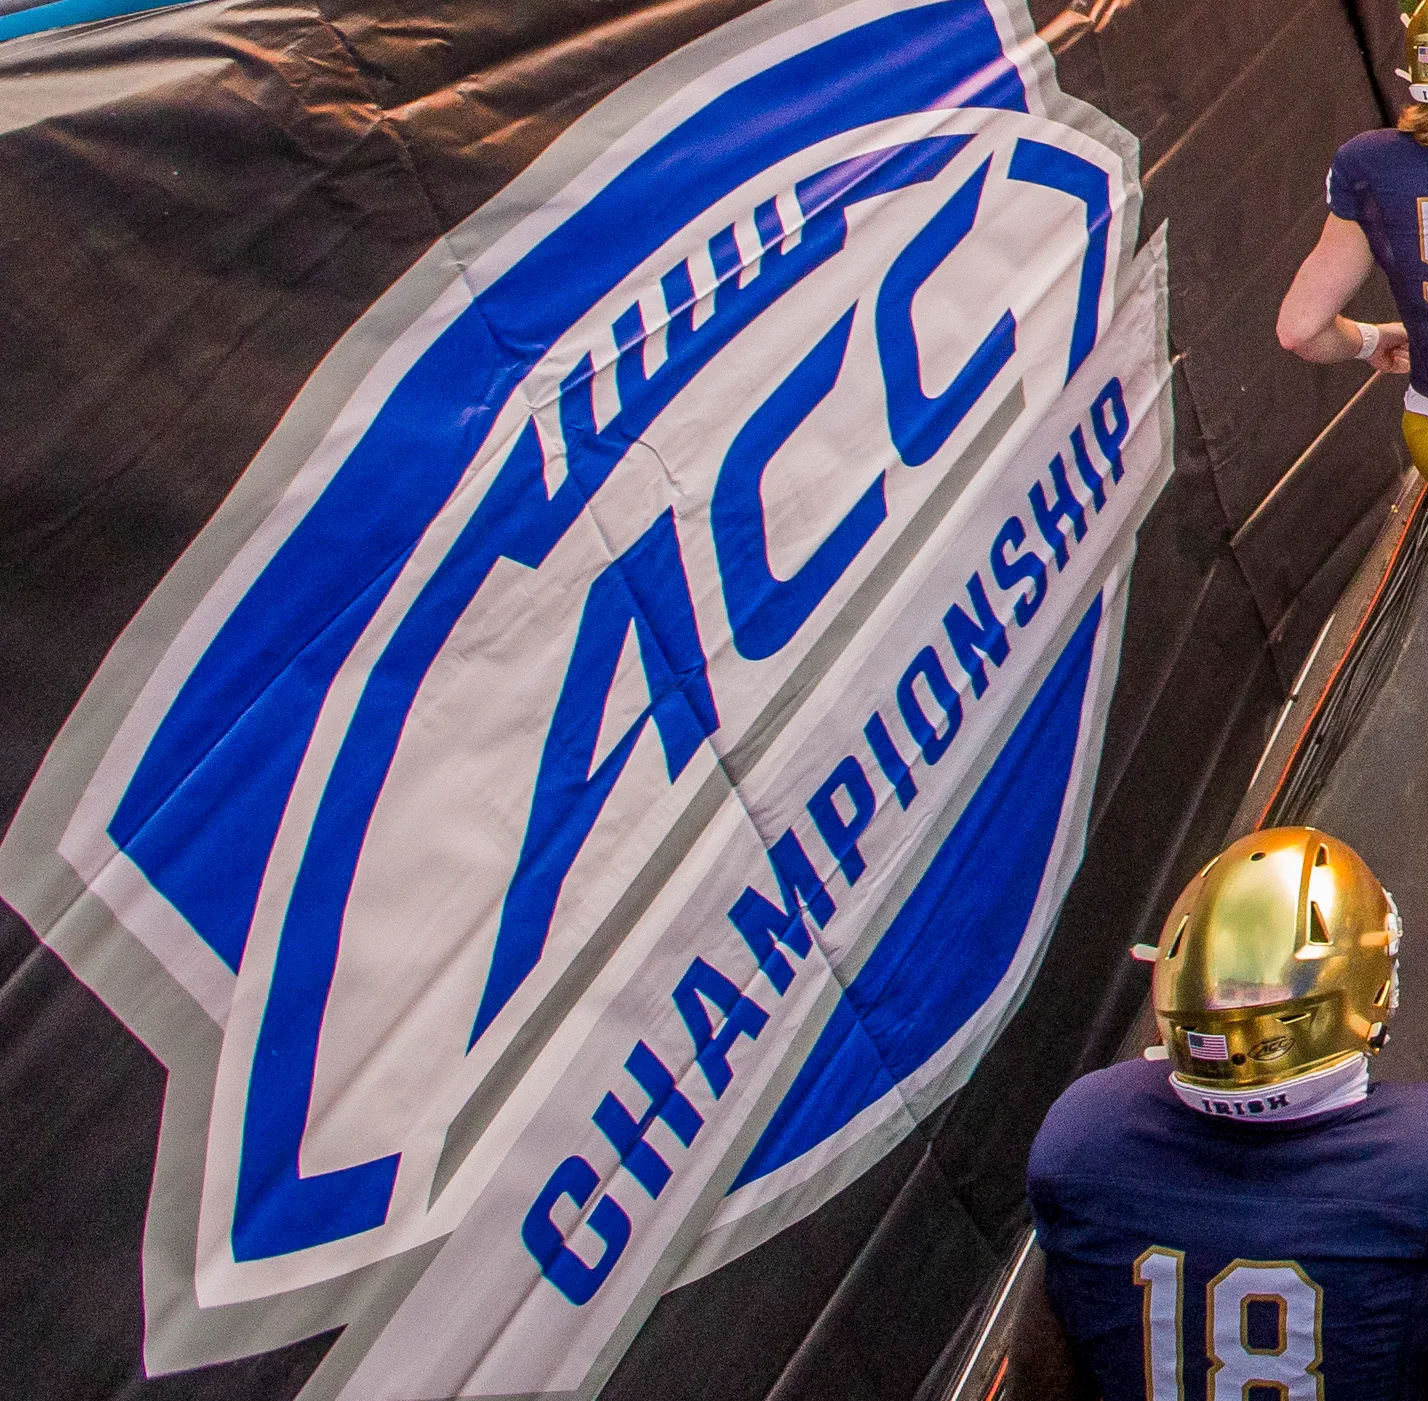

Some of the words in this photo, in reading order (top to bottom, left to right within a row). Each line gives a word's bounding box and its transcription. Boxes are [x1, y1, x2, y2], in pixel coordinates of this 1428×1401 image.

[466, 147, 1018, 1057] ACC
[520, 374, 1133, 1308] CHAMPIONSHIP
[1132, 1244, 1326, 1401] 18
[1200, 1093, 1291, 1115] IRISH
